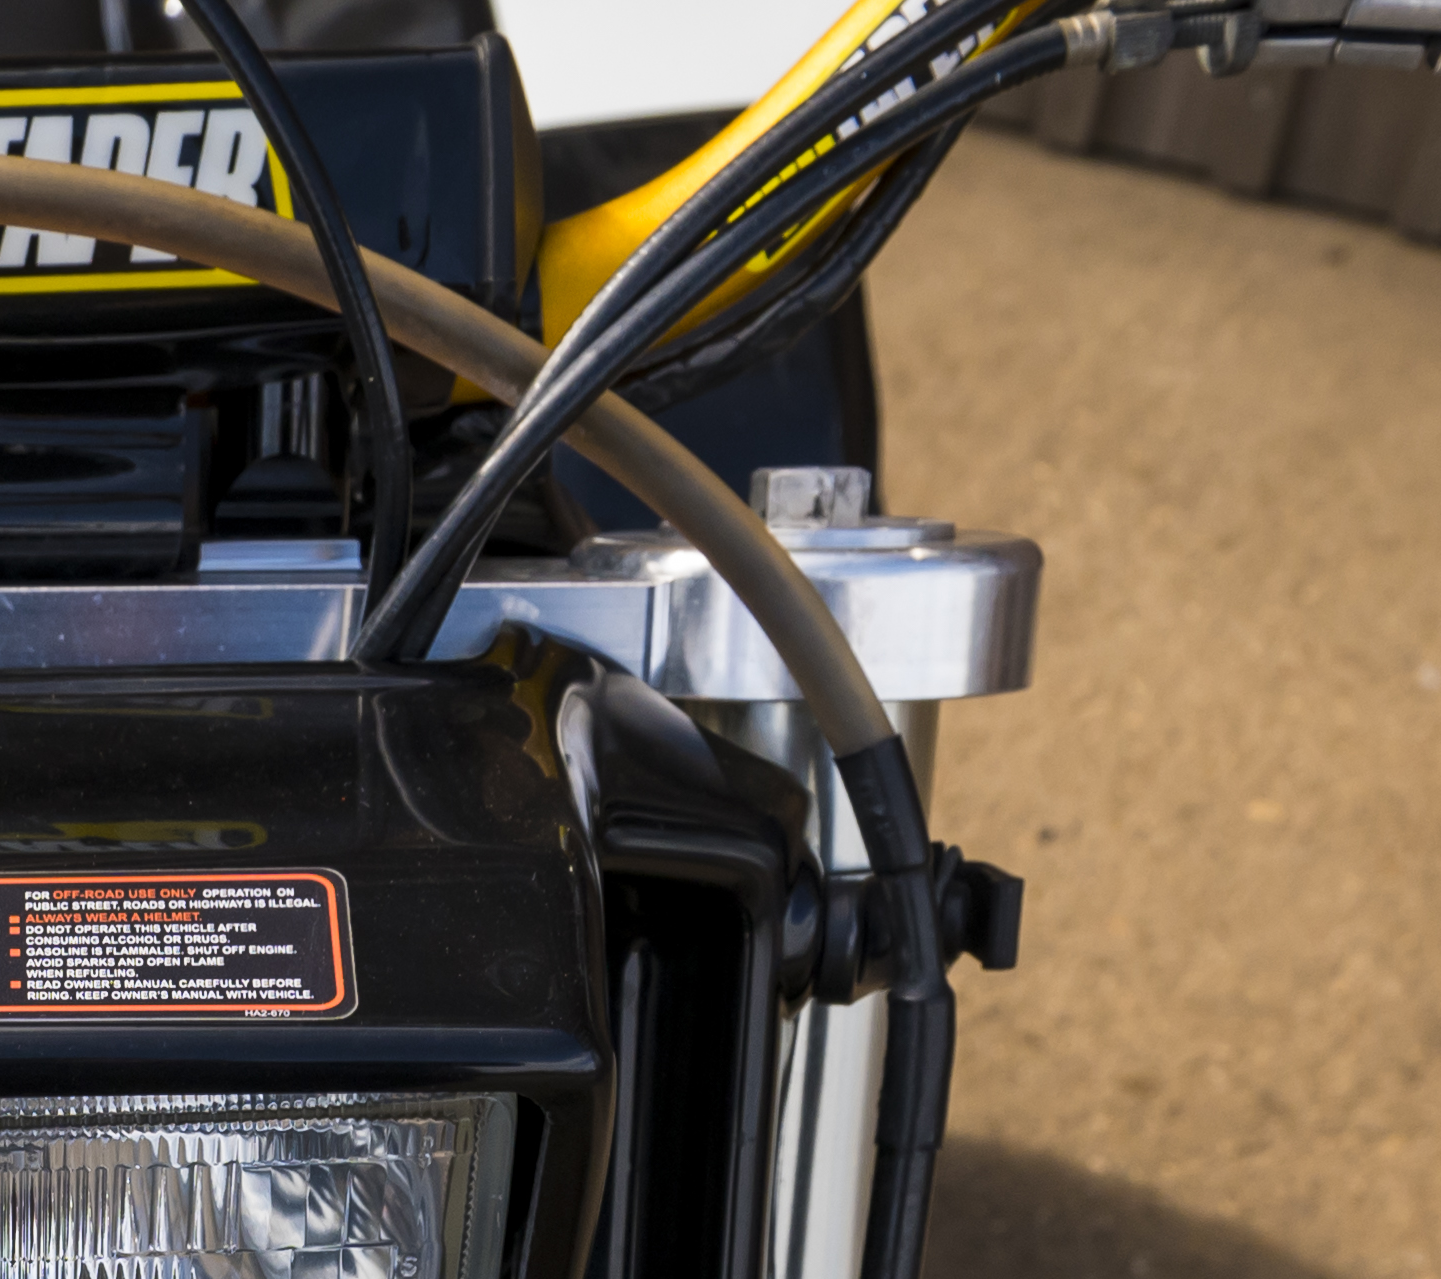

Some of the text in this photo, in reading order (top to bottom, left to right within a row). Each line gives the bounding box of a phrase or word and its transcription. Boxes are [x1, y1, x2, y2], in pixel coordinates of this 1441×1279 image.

[25, 888, 294, 900] FOR OFF-ROAD USE ONLY OPERATION ON
[25, 898, 320, 910] PUBLIC STREET, ROADS OR HIGHWAYS IS ILLEGAL.
[26, 912, 202, 923] ALWAYS WEAR A HELMET.
[26, 923, 257, 934] DO NOT OPERATE THIS VEHICLE AFTER
[26, 935, 230, 945] CONSUMING ALCOHOL OR DRUGS.
[26, 945, 297, 956] GASOLINE IS FLAMMALBE. SHUT OFF ENGINE.
[26, 957, 224, 968] AVOID SPARKS AND OPEN FLAME
[26, 969, 138, 978] WHEN REFUELING.
[27, 978, 301, 989] READ OWNER'S MANUAL CAREFULLY BEFORE
[27, 990, 314, 1000] RIDING. KEEP OWNER'S MANUAL WITH VEHICLE.
